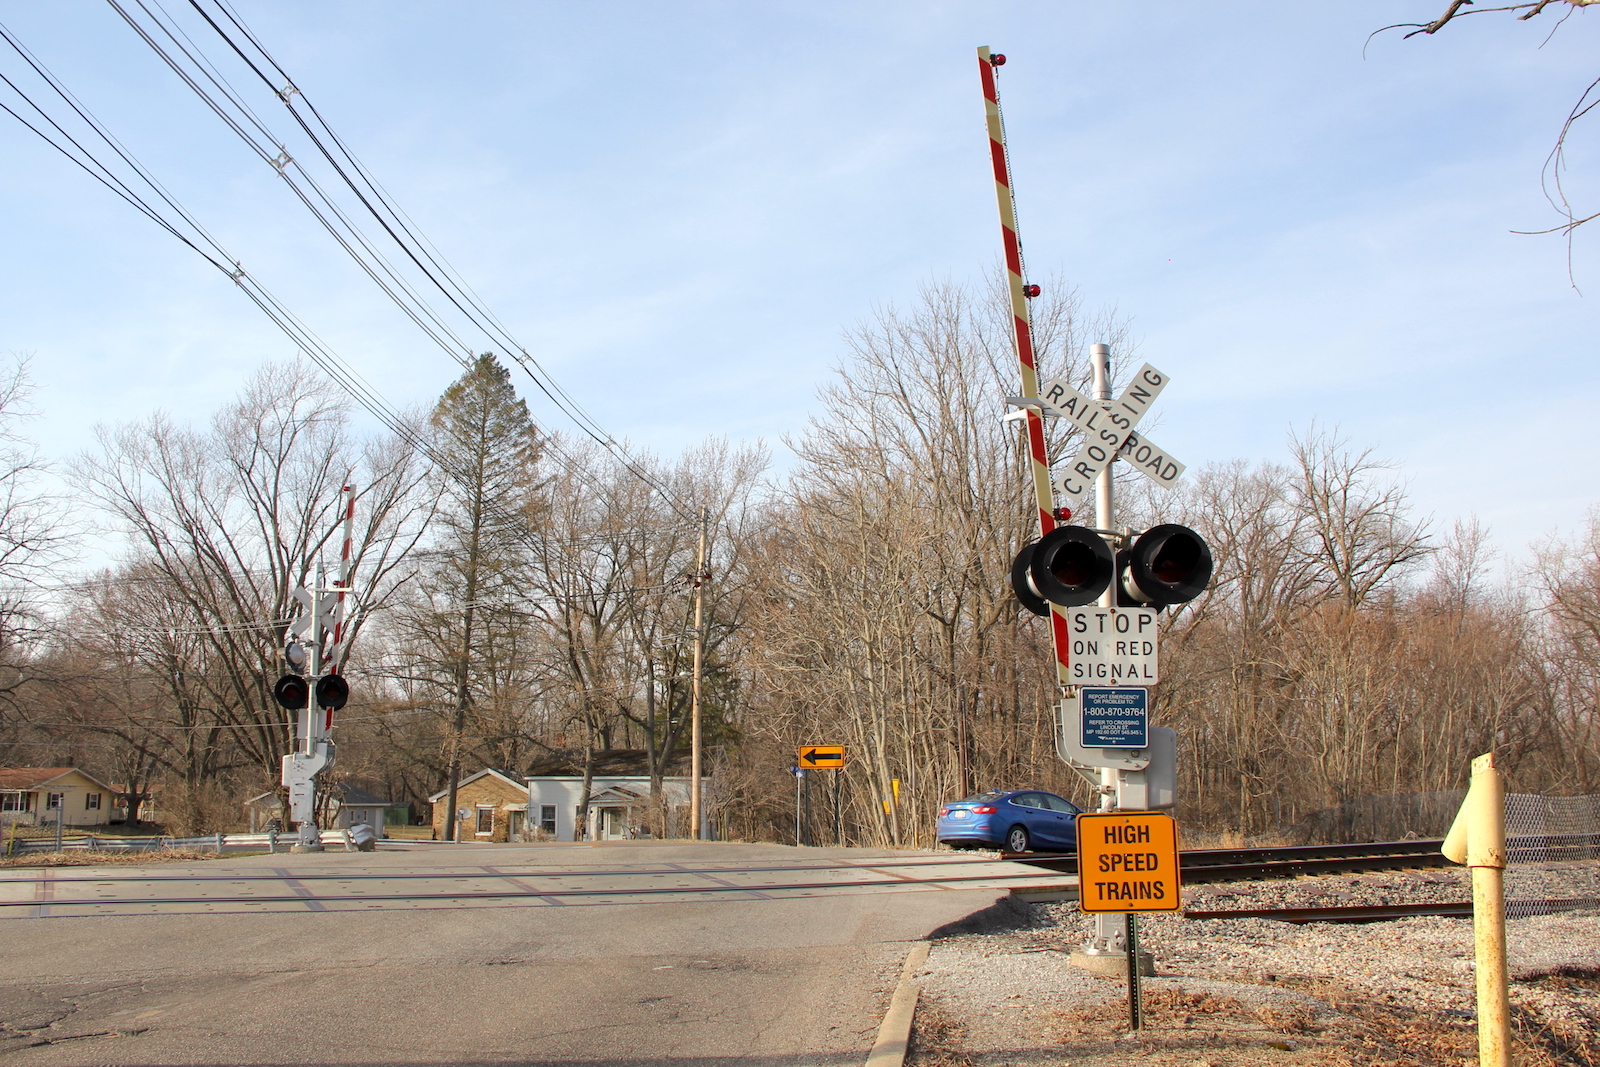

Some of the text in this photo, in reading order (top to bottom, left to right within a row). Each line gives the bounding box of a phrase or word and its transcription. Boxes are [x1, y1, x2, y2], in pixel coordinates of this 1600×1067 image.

[1046, 383, 1178, 481] RAIL ROAD
[1063, 369, 1162, 495] CROSSING
[1074, 613, 1152, 633] STOP
[1074, 640, 1153, 656] ON RED
[1074, 663, 1153, 678] SIGNAL
[1083, 707, 1144, 716] 1-800-870-9764
[1104, 825, 1150, 844] HIGH
[1098, 853, 1158, 872] SPEED
[1095, 880, 1165, 900] TRAINS
